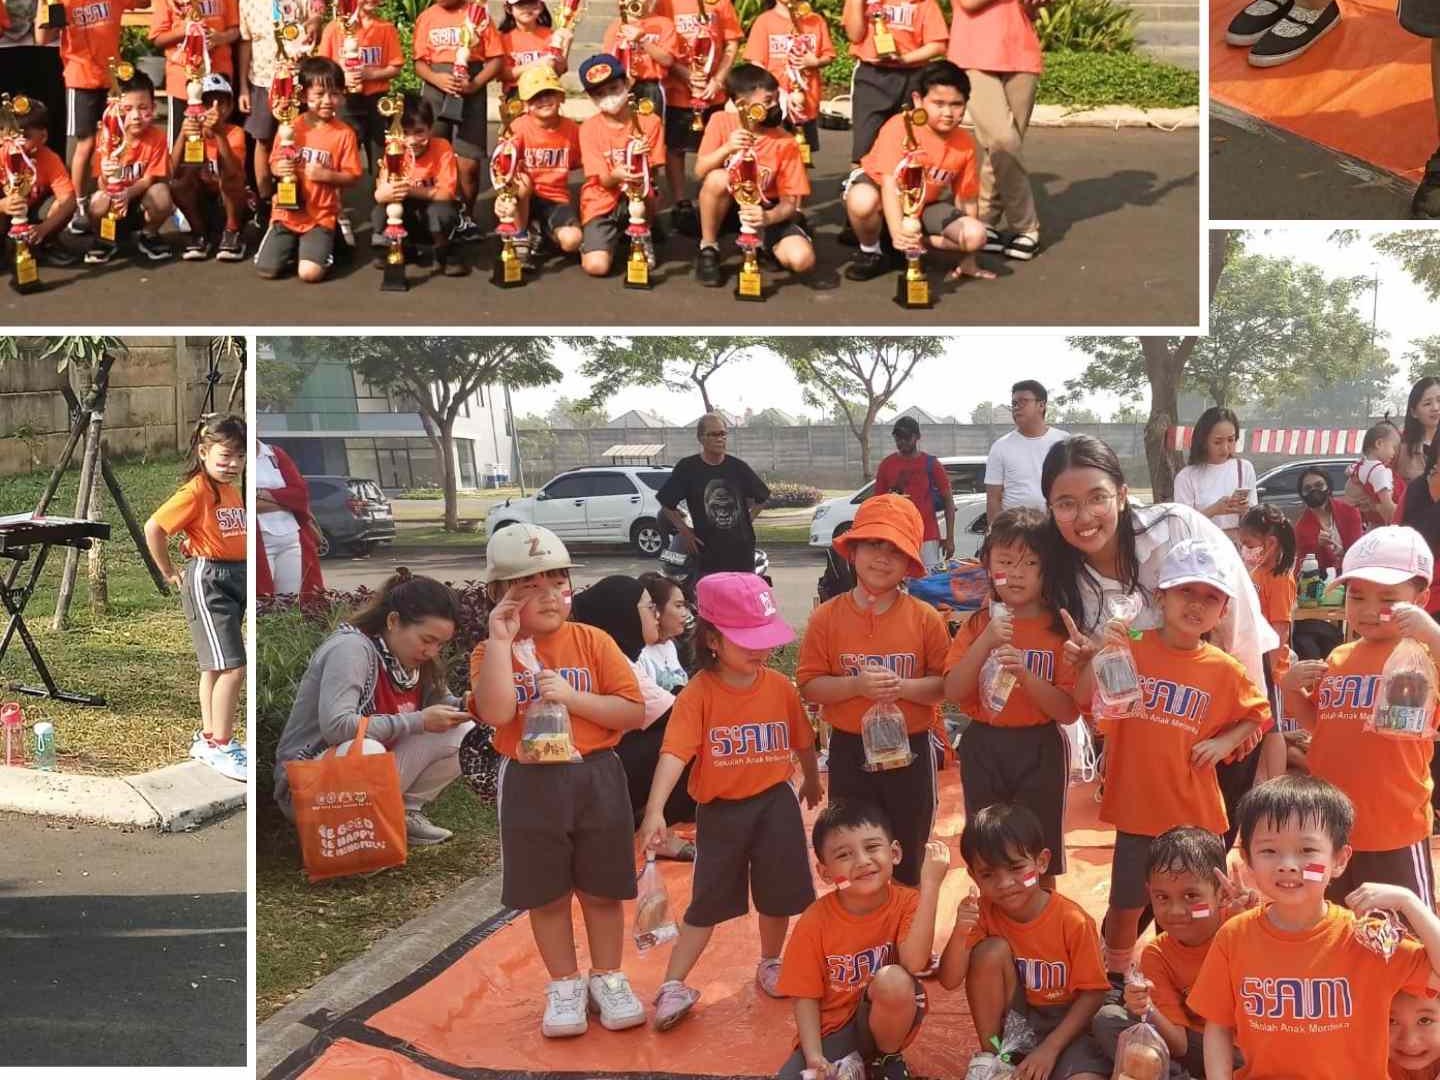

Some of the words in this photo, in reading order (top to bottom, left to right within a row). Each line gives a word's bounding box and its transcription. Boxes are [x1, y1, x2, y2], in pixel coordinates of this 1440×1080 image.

[709, 721, 791, 757] SAM
[1240, 976, 1353, 1020] SAM
[1280, 1022, 1305, 1033] Anak
